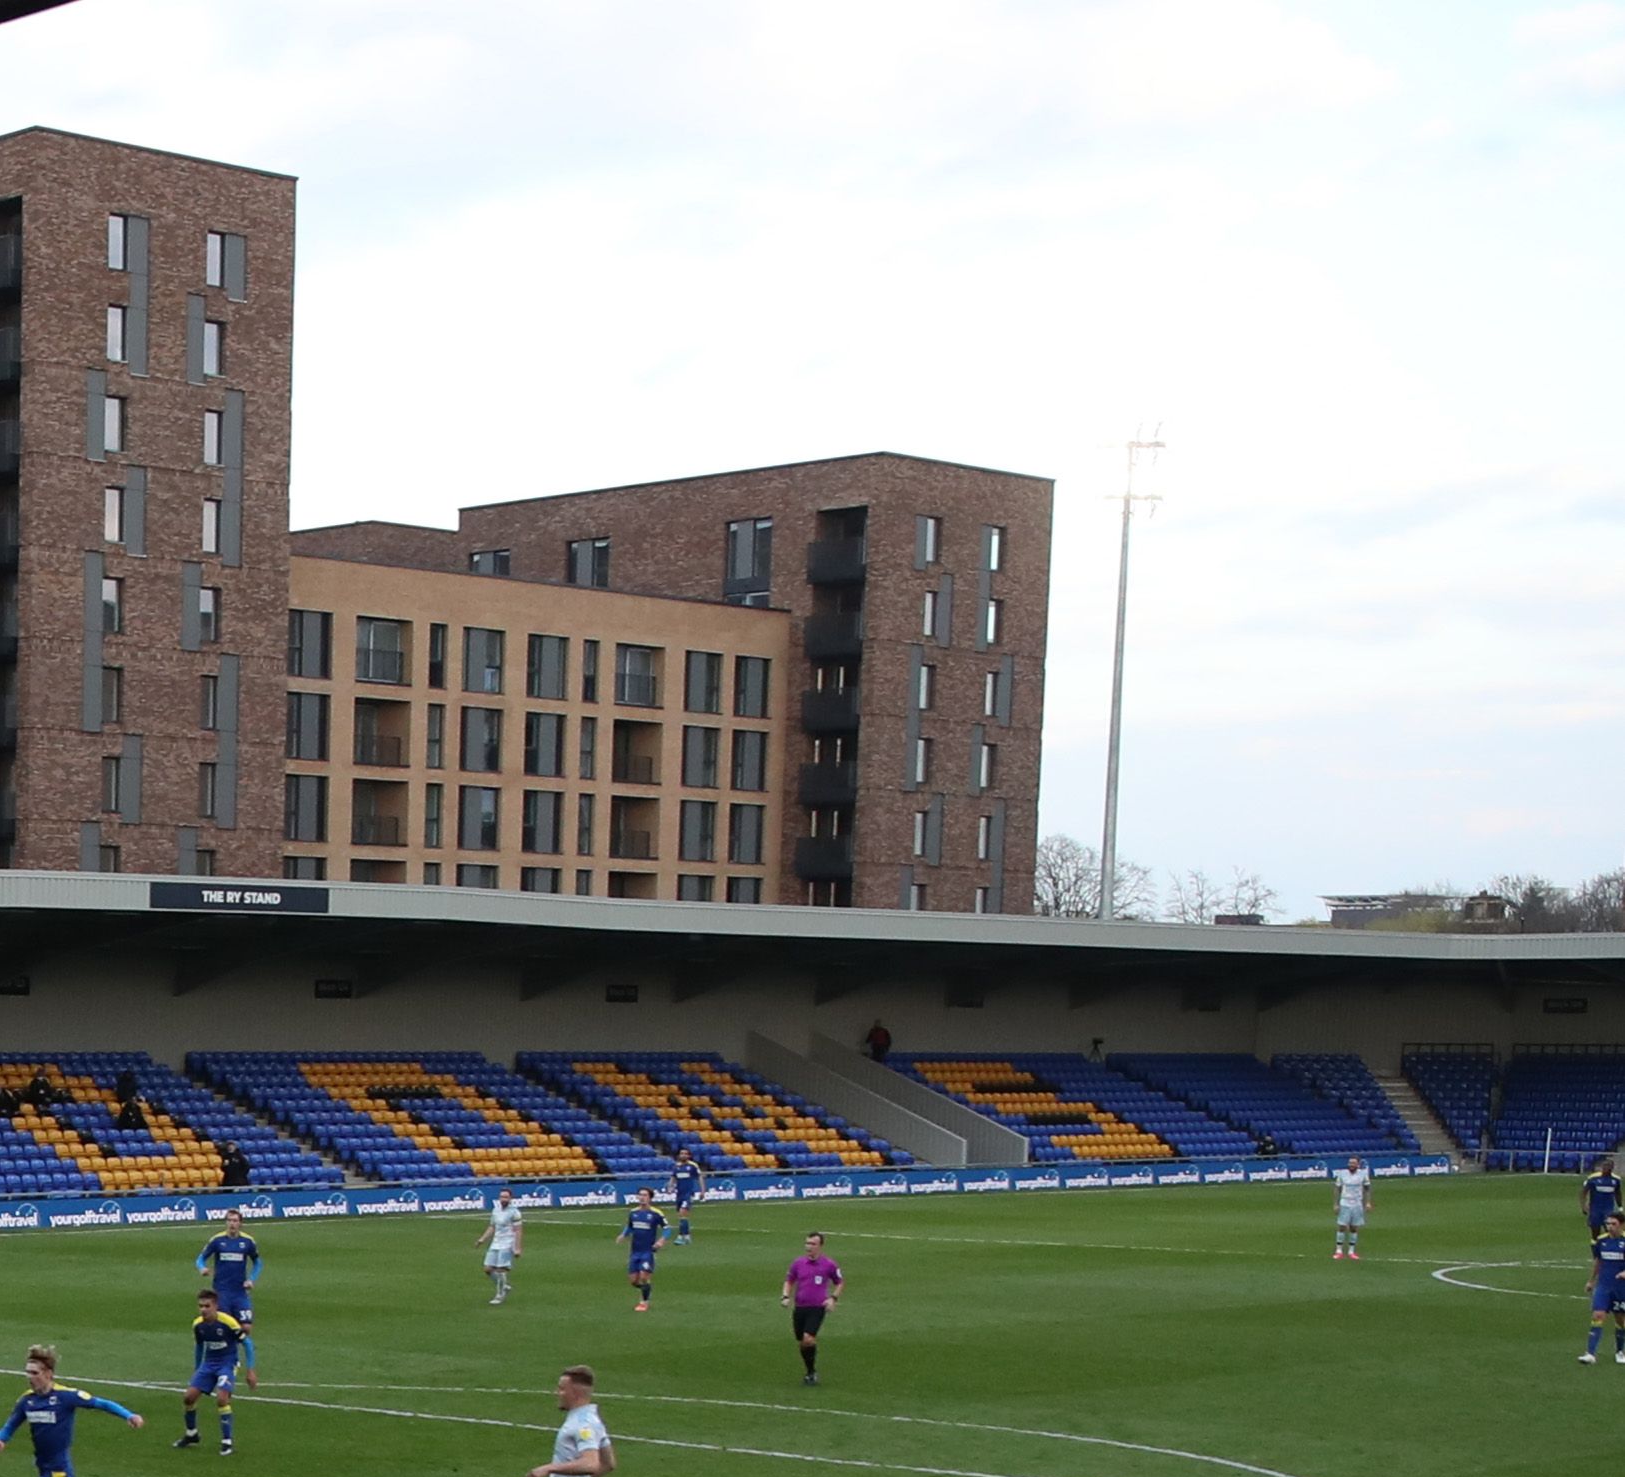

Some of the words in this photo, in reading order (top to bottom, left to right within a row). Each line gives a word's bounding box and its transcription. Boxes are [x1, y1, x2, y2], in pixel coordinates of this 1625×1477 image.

[201, 890, 224, 903] THE
[225, 891, 242, 904] RY
[243, 891, 282, 905] STAND
[49, 1207, 122, 1228] yourgolftravel
[126, 1204, 198, 1223] yourgolftravel
[238, 1309, 253, 1321] 39
